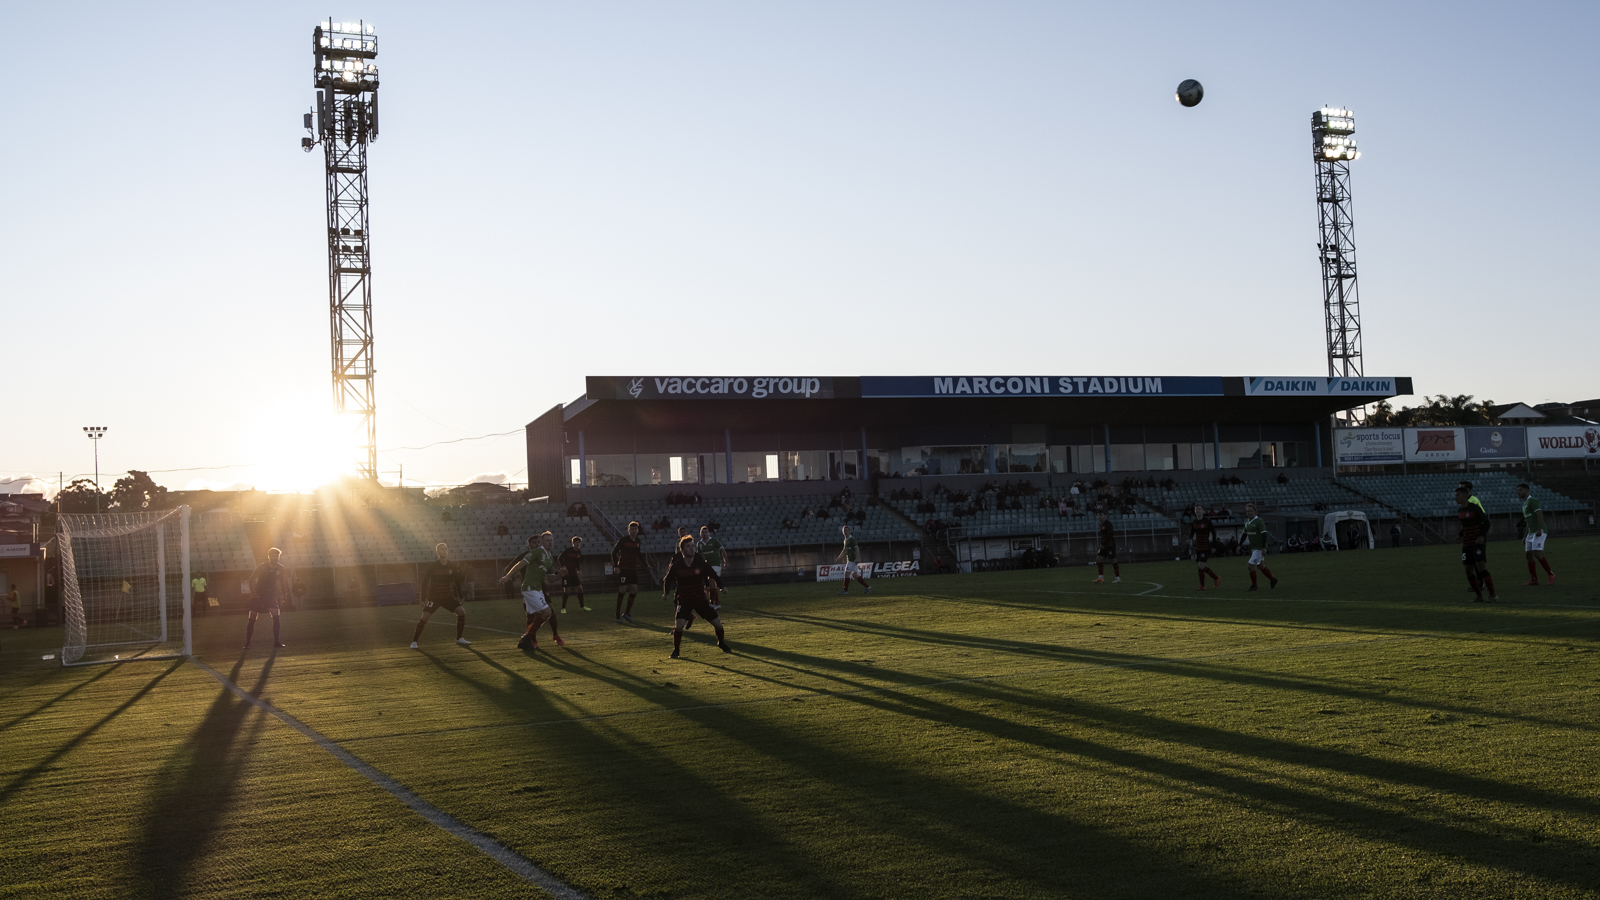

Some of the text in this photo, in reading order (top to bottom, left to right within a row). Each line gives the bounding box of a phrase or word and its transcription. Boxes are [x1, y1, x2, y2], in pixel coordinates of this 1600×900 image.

[654, 377, 820, 398] vaccaro group
[933, 377, 1163, 394] MARCONI STADIUM
[1264, 380, 1317, 391] DAIKIN
[1340, 380, 1390, 391] DAIKIN
[1356, 432, 1400, 441] sports focus
[1538, 436, 1584, 449] WORLD
[874, 560, 920, 572] LEGEA
